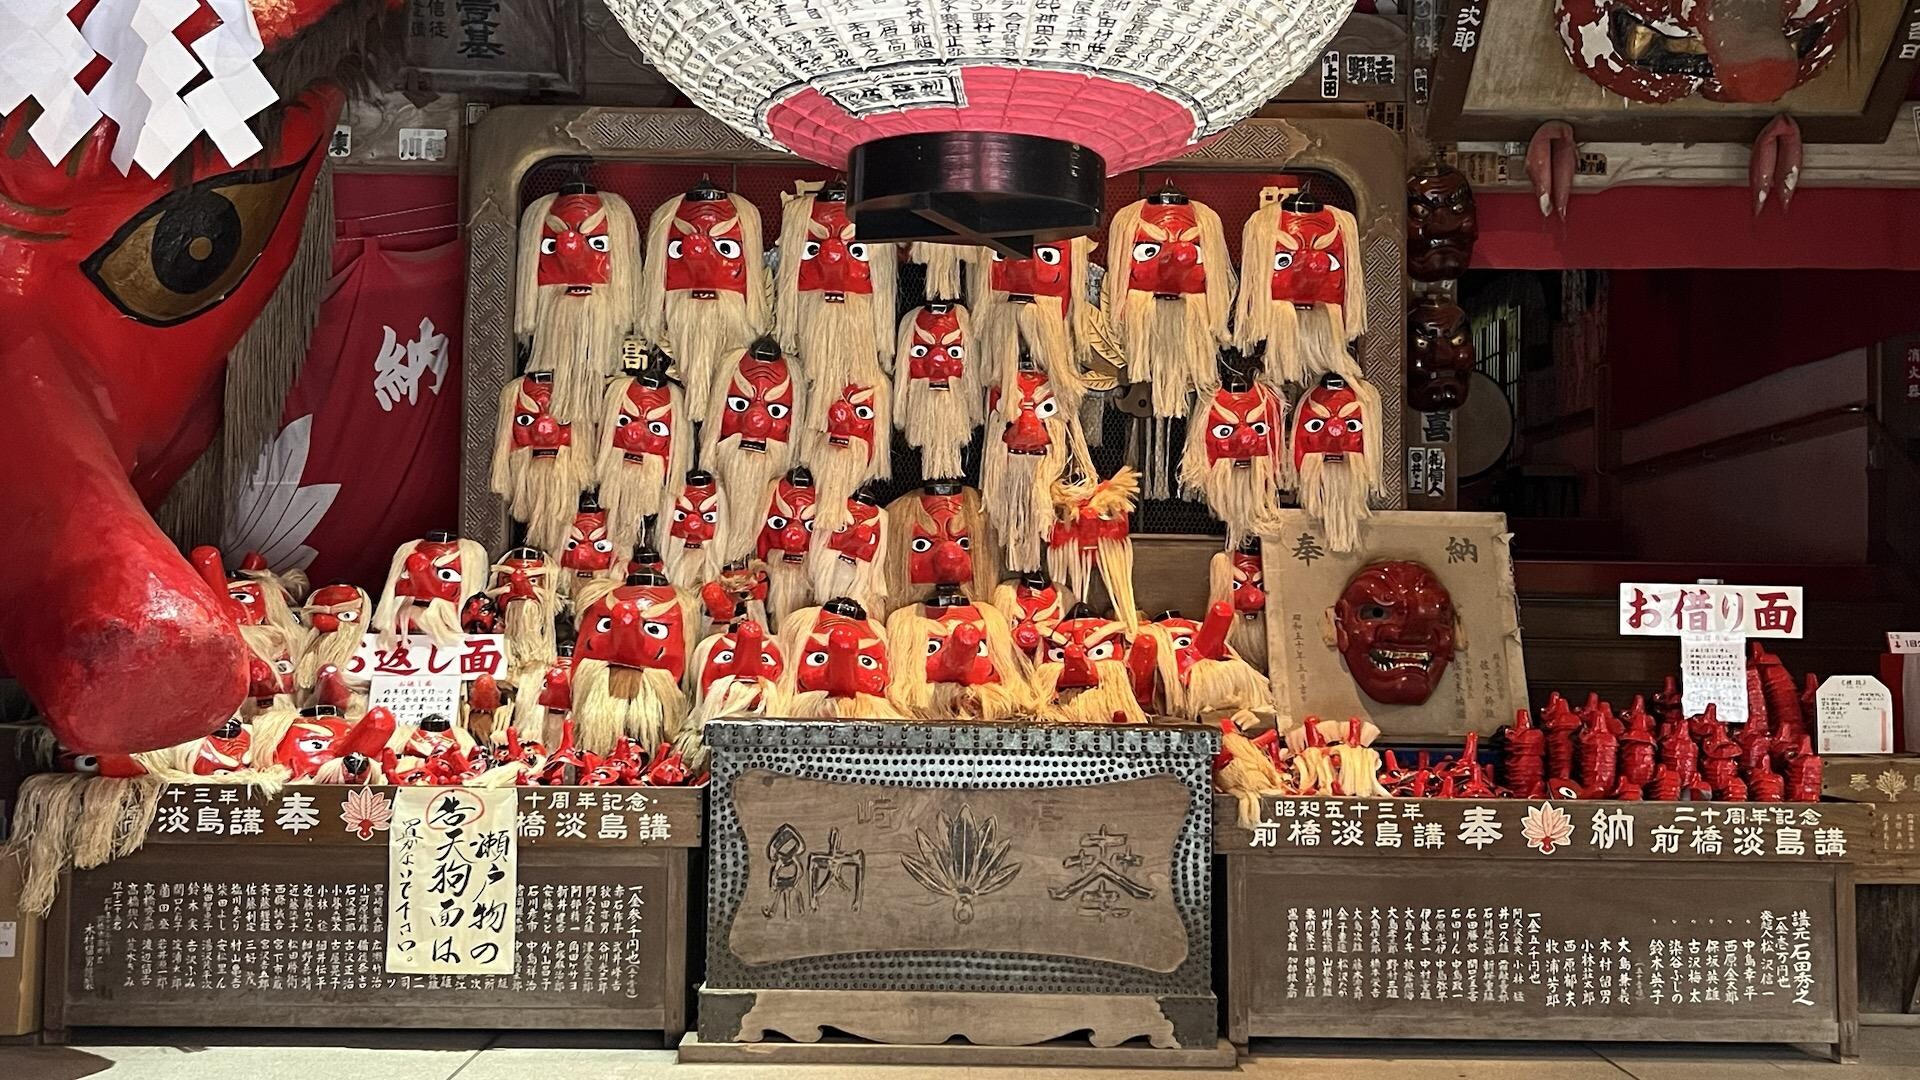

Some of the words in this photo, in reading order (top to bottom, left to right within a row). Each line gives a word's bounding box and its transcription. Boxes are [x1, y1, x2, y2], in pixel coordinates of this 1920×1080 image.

[373, 316, 449, 412] 納
[1292, 532, 1325, 567] 奉
[1444, 536, 1479, 565] 納
[1626, 588, 1797, 634] お借り面
[157, 805, 266, 837] 淡島講
[275, 792, 320, 836] 奉
[429, 796, 476, 826] 告
[1275, 800, 1425, 822] 昭和五十三年
[1456, 806, 1504, 851] 奉
[1588, 807, 1635, 850] 納
[1674, 806, 1823, 827] 二十周年記念
[1249, 818, 1446, 850] 前橋淡島講
[1650, 824, 1848, 857] 前橋淡島講
[217, 882, 228, 931] 柴田よし
[426, 827, 476, 964] 天狗面は
[468, 829, 511, 965] 瀬戸物の
[1742, 938, 1758, 1002] 中島幸平
